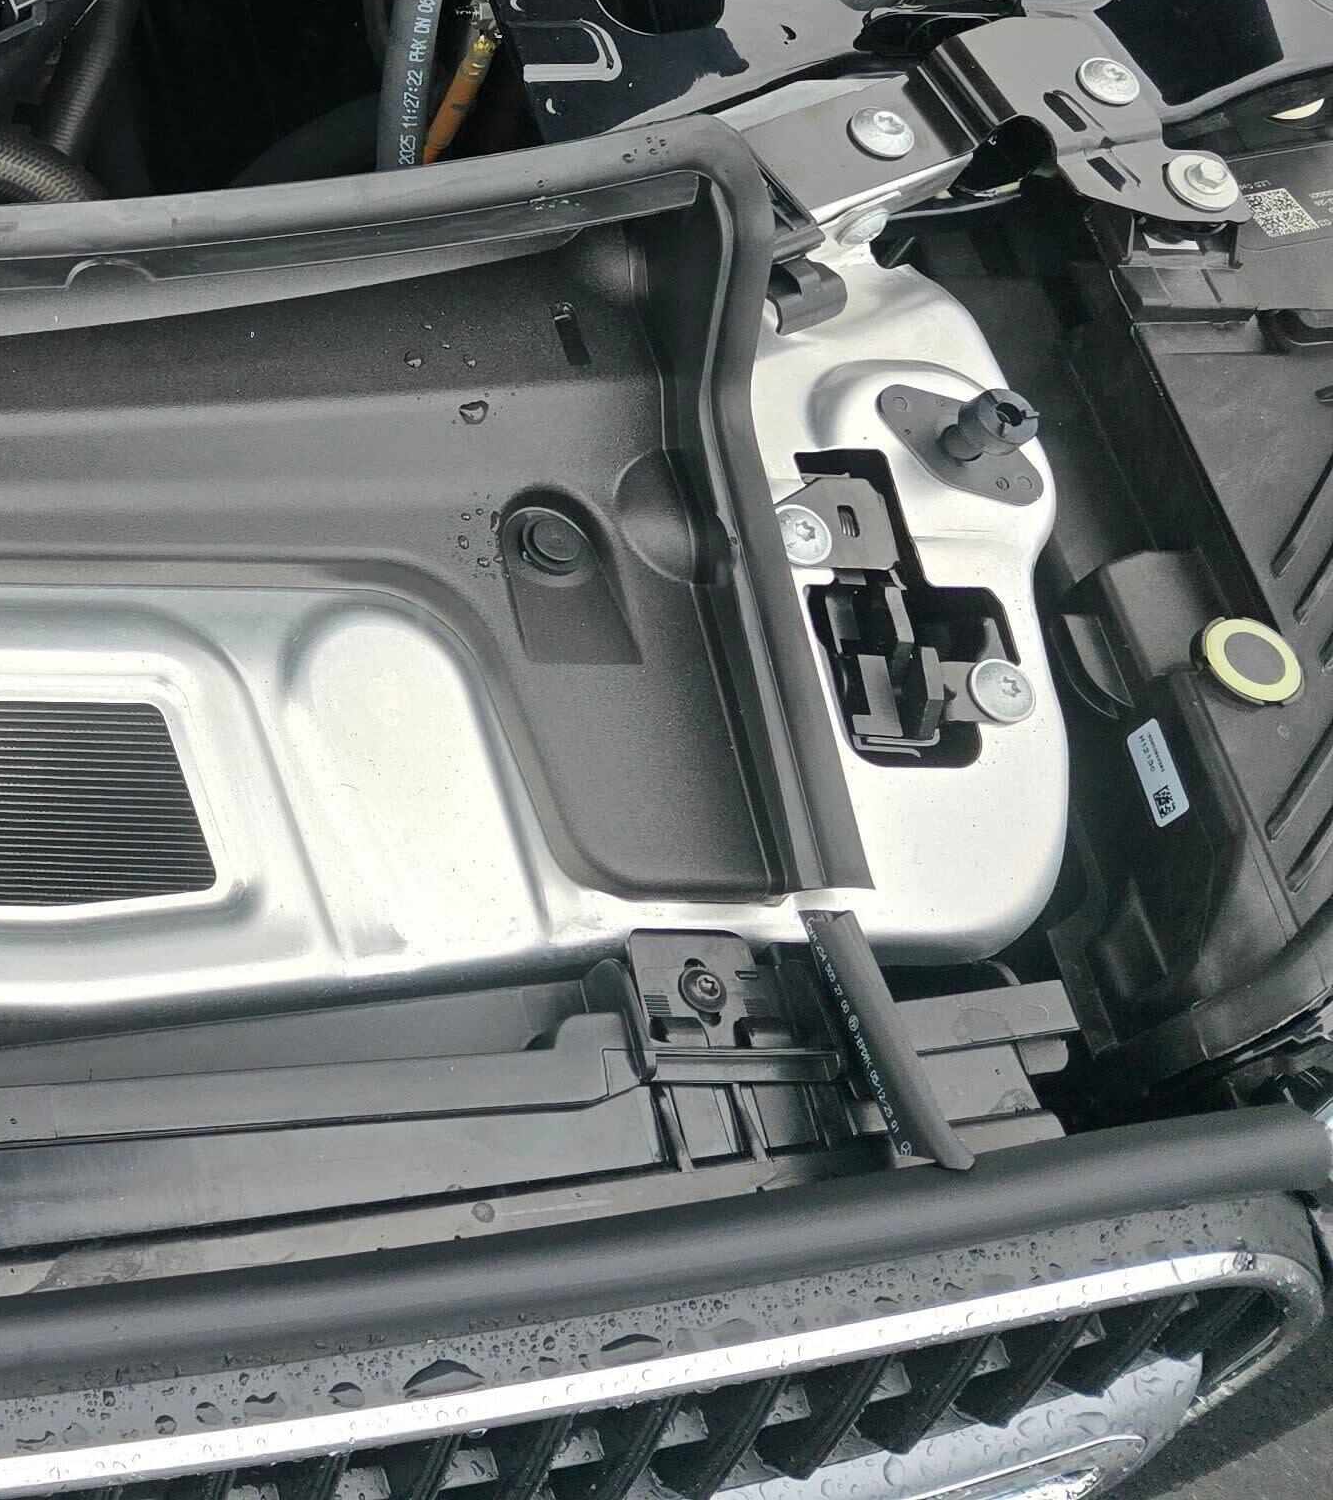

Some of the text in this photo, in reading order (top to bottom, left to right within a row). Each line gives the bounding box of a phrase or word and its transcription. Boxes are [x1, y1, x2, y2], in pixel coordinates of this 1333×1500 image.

[413, 16, 431, 34] DN
[401, 68, 424, 129] 11:27:22
[399, 134, 417, 165] 2025
